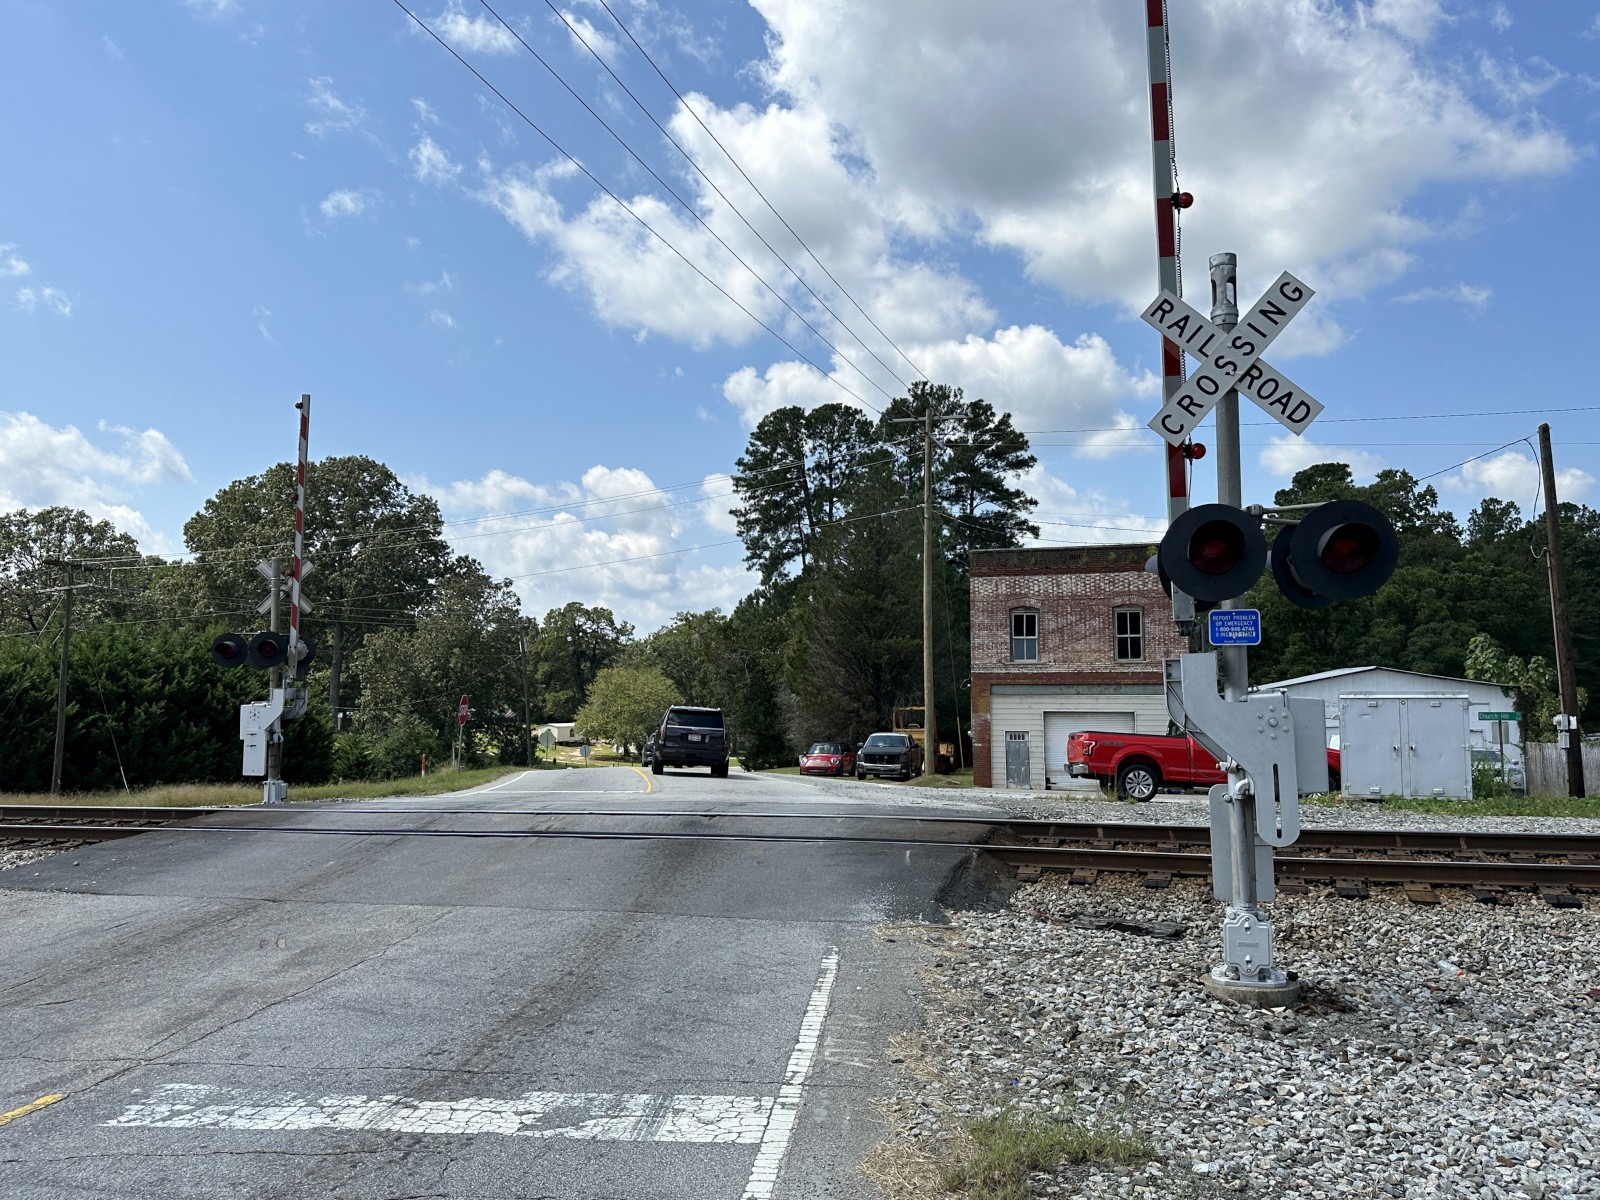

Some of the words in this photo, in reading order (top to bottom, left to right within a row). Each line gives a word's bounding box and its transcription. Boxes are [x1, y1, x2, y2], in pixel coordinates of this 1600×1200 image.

[1149, 298, 1216, 358] RAIL
[1238, 363, 1311, 424] ROAD
[1161, 281, 1304, 435] CROSSING
